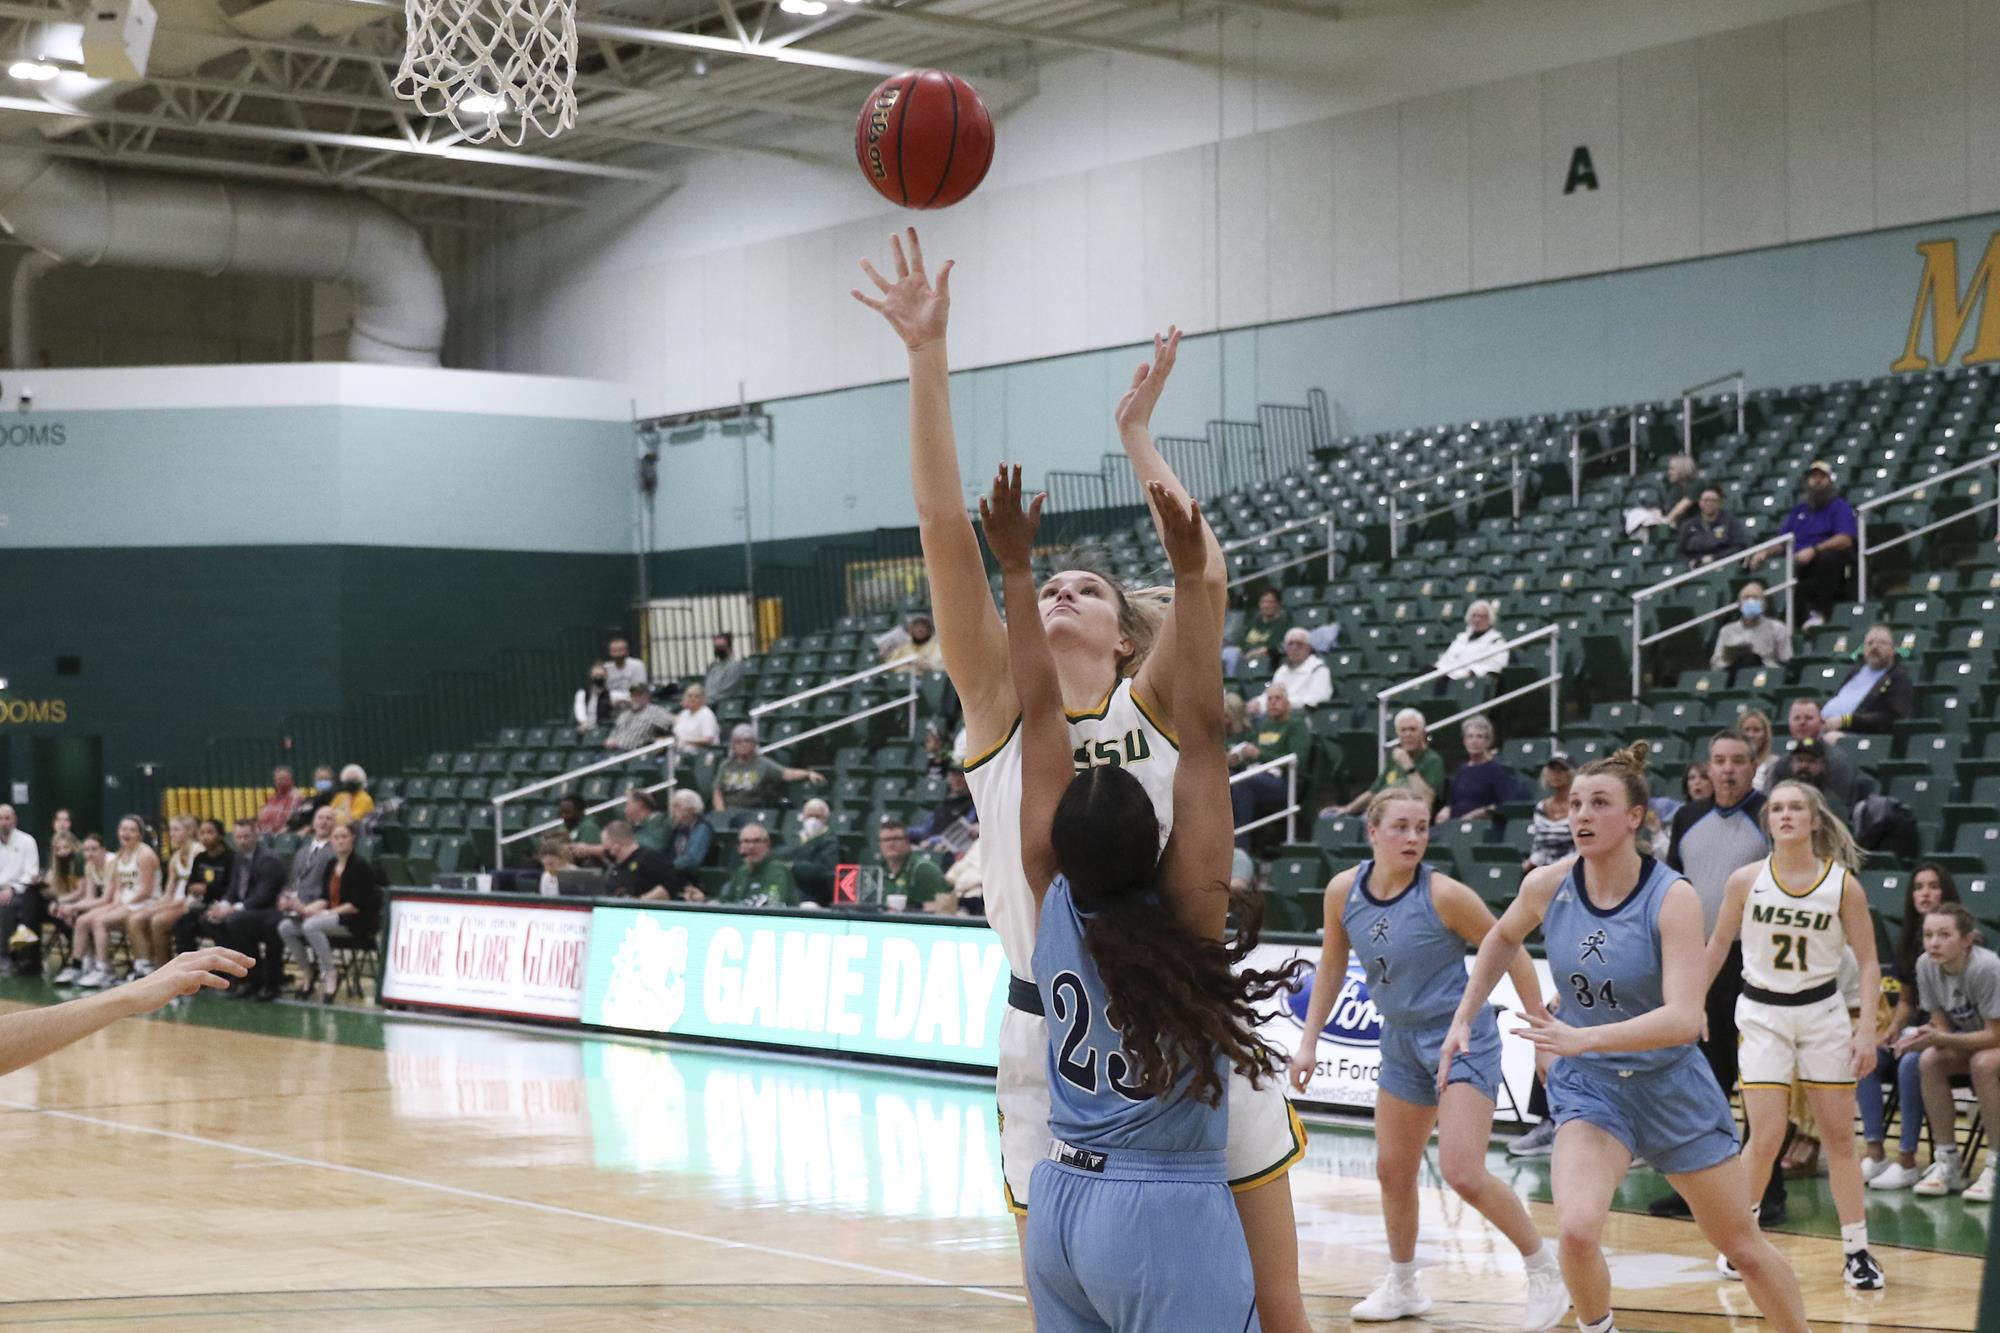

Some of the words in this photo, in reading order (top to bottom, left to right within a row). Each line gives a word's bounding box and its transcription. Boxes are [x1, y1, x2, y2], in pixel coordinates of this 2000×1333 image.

[868, 85, 901, 181] Wilson
[1564, 145, 1599, 194] A
[1073, 728, 1152, 773] SSU
[1752, 904, 1832, 931] MSSU
[523, 920, 586, 990] GLOBE
[1771, 933, 1808, 973] 21
[703, 926, 868, 1036] GAME
[875, 937, 1003, 1048] DAY
[1569, 972, 1618, 1010] 34
